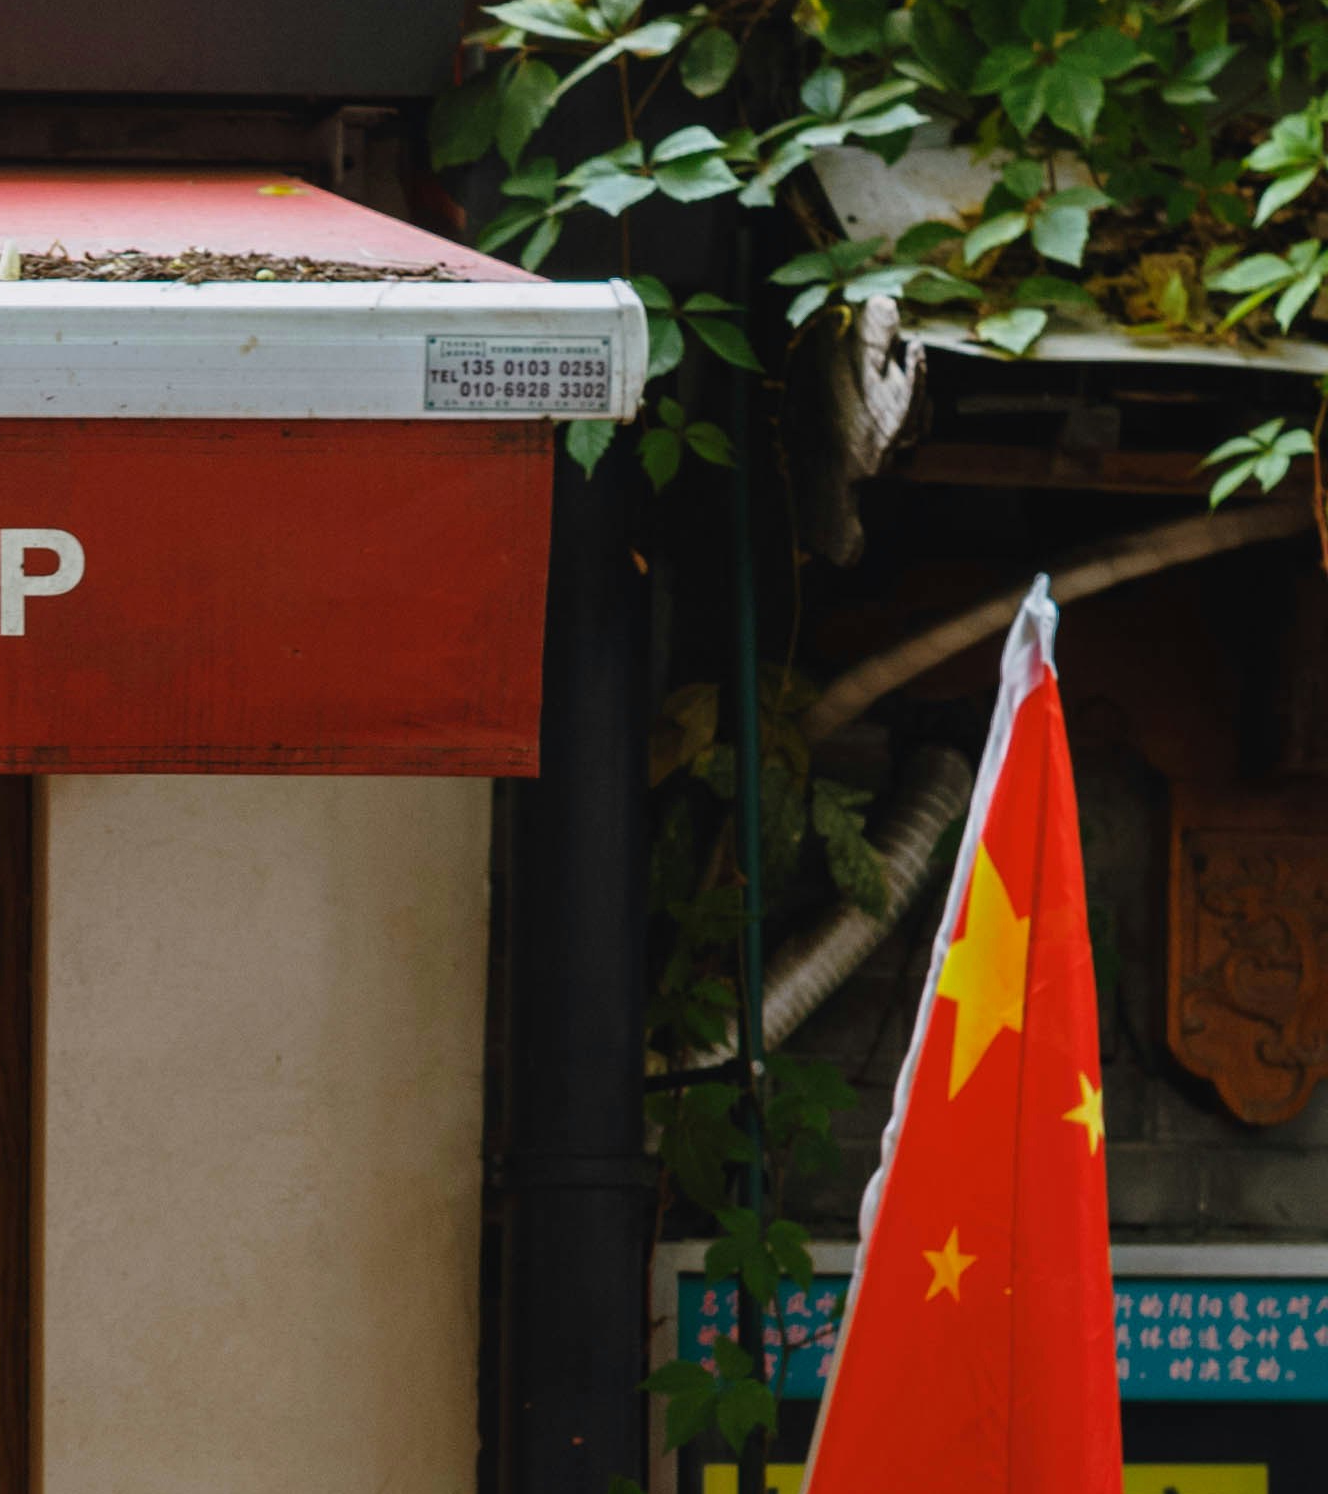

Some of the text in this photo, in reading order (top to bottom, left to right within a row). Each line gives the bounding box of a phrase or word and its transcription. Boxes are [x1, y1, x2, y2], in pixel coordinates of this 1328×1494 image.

[461, 360, 605, 377] 135 0103 0253
[430, 370, 458, 384] TEL
[559, 382, 606, 398] 3302
